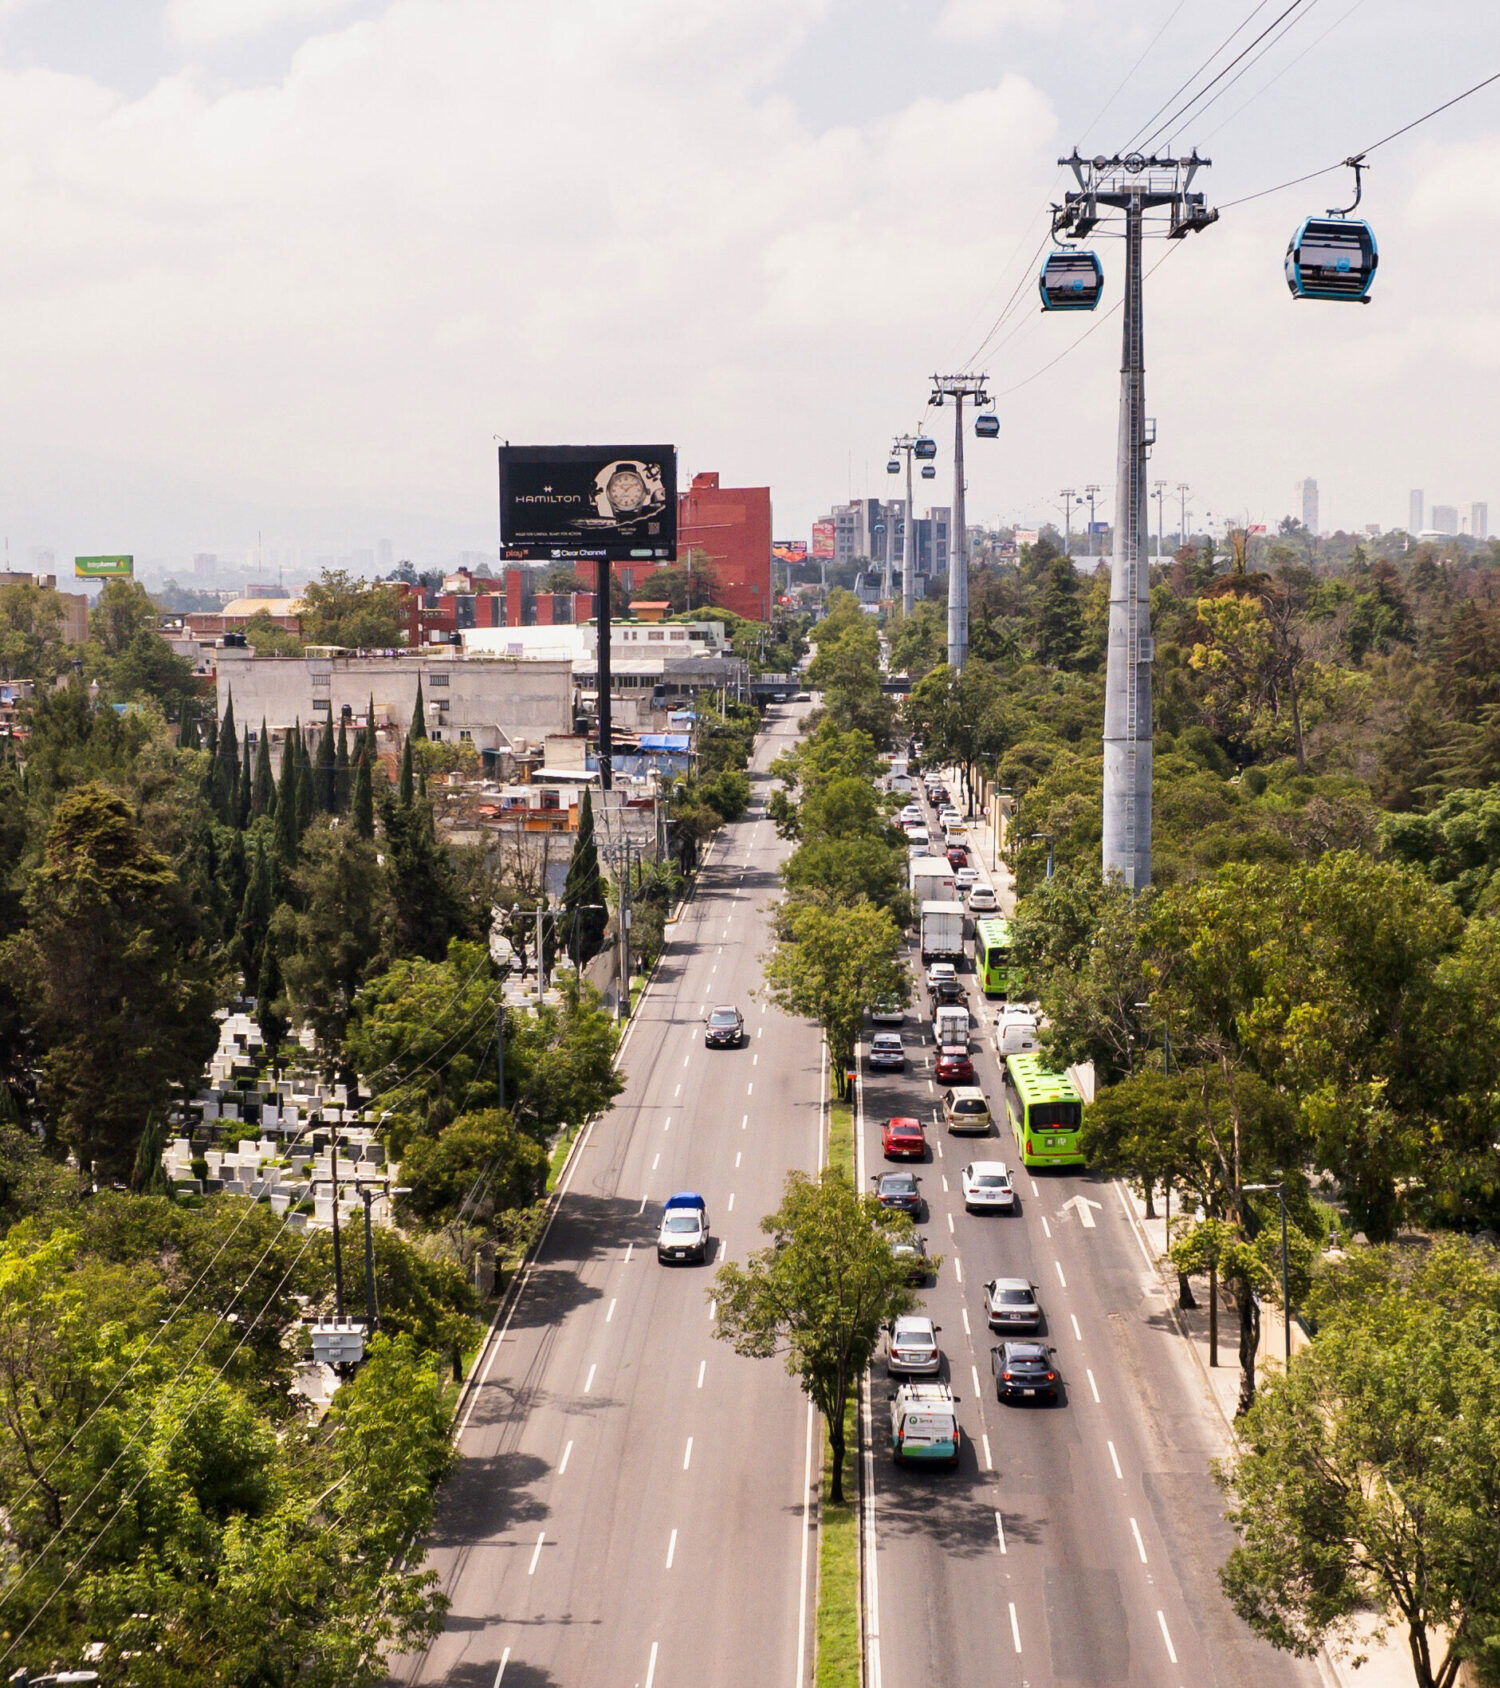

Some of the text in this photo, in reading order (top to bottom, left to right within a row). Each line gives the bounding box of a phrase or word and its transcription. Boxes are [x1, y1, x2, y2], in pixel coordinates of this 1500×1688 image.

[515, 495, 581, 503] HAMILTON
[561, 549, 607, 557] Clear Channel
